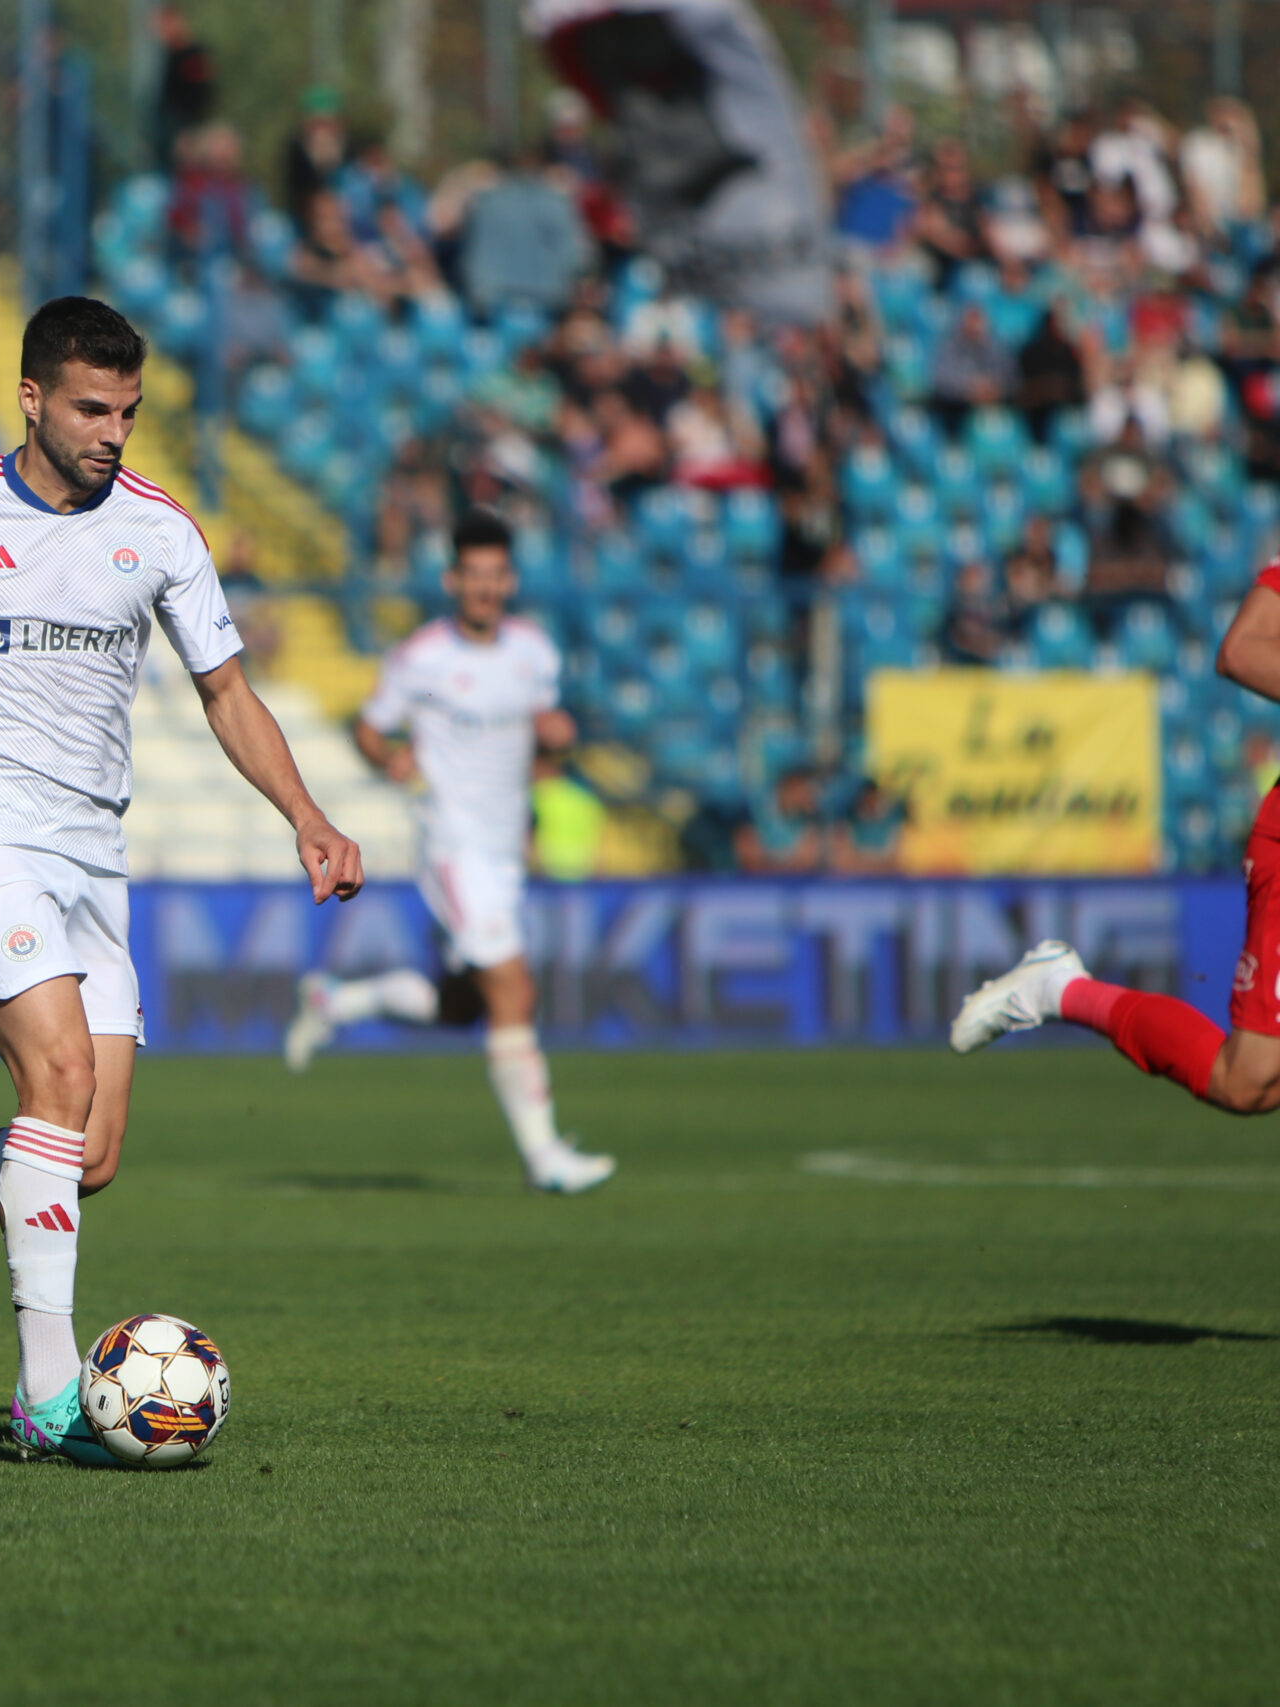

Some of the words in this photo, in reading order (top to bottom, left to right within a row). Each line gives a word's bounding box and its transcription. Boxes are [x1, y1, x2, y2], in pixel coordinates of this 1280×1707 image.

[21, 622, 133, 654] LIBERTY
[213, 615, 234, 631] VA
[158, 886, 1178, 1036] MAKETING
